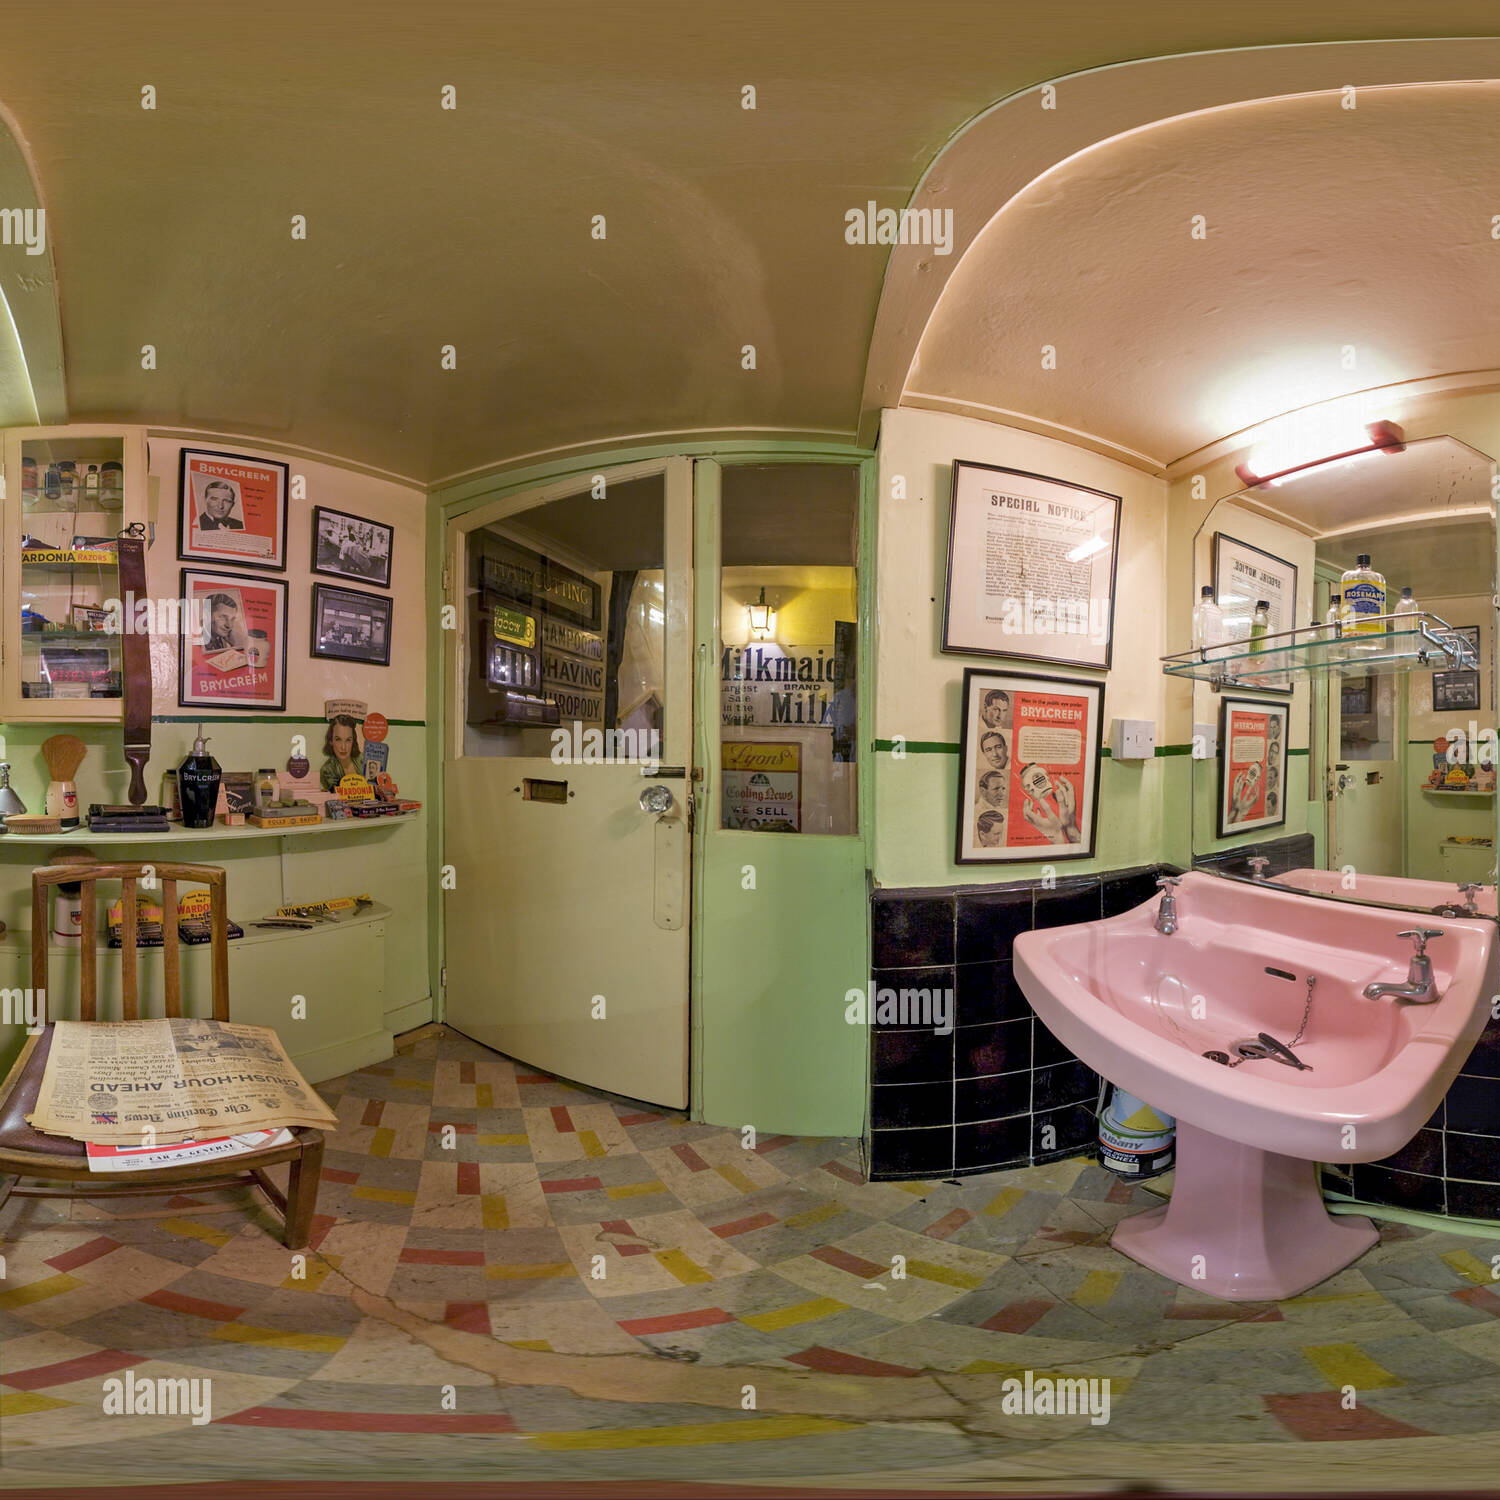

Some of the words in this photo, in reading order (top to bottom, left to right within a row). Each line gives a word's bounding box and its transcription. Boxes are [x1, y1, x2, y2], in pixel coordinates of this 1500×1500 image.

[200, 463, 270, 481] BRYLCREEM
[991, 495, 1040, 512] SPECIAL
[22, 552, 76, 563] ARDONIA
[1347, 591, 1384, 599] ROSEMARY
[543, 623, 602, 658] HAMPOOING
[200, 672, 268, 692] BRYLCREEM
[722, 685, 758, 694] argest
[1021, 706, 1081, 720] BRYLCREEM
[336, 786, 373, 795] WARDONIA
[765, 787, 793, 800] News
[91, 1082, 163, 1092] AHEAD
[173, 1075, 299, 1089] CRUSH-HOUR
[166, 1108, 218, 1120] Evening
[224, 1103, 251, 1116] The
[124, 1111, 162, 1123] News
[1102, 1132, 1144, 1149] Albany
